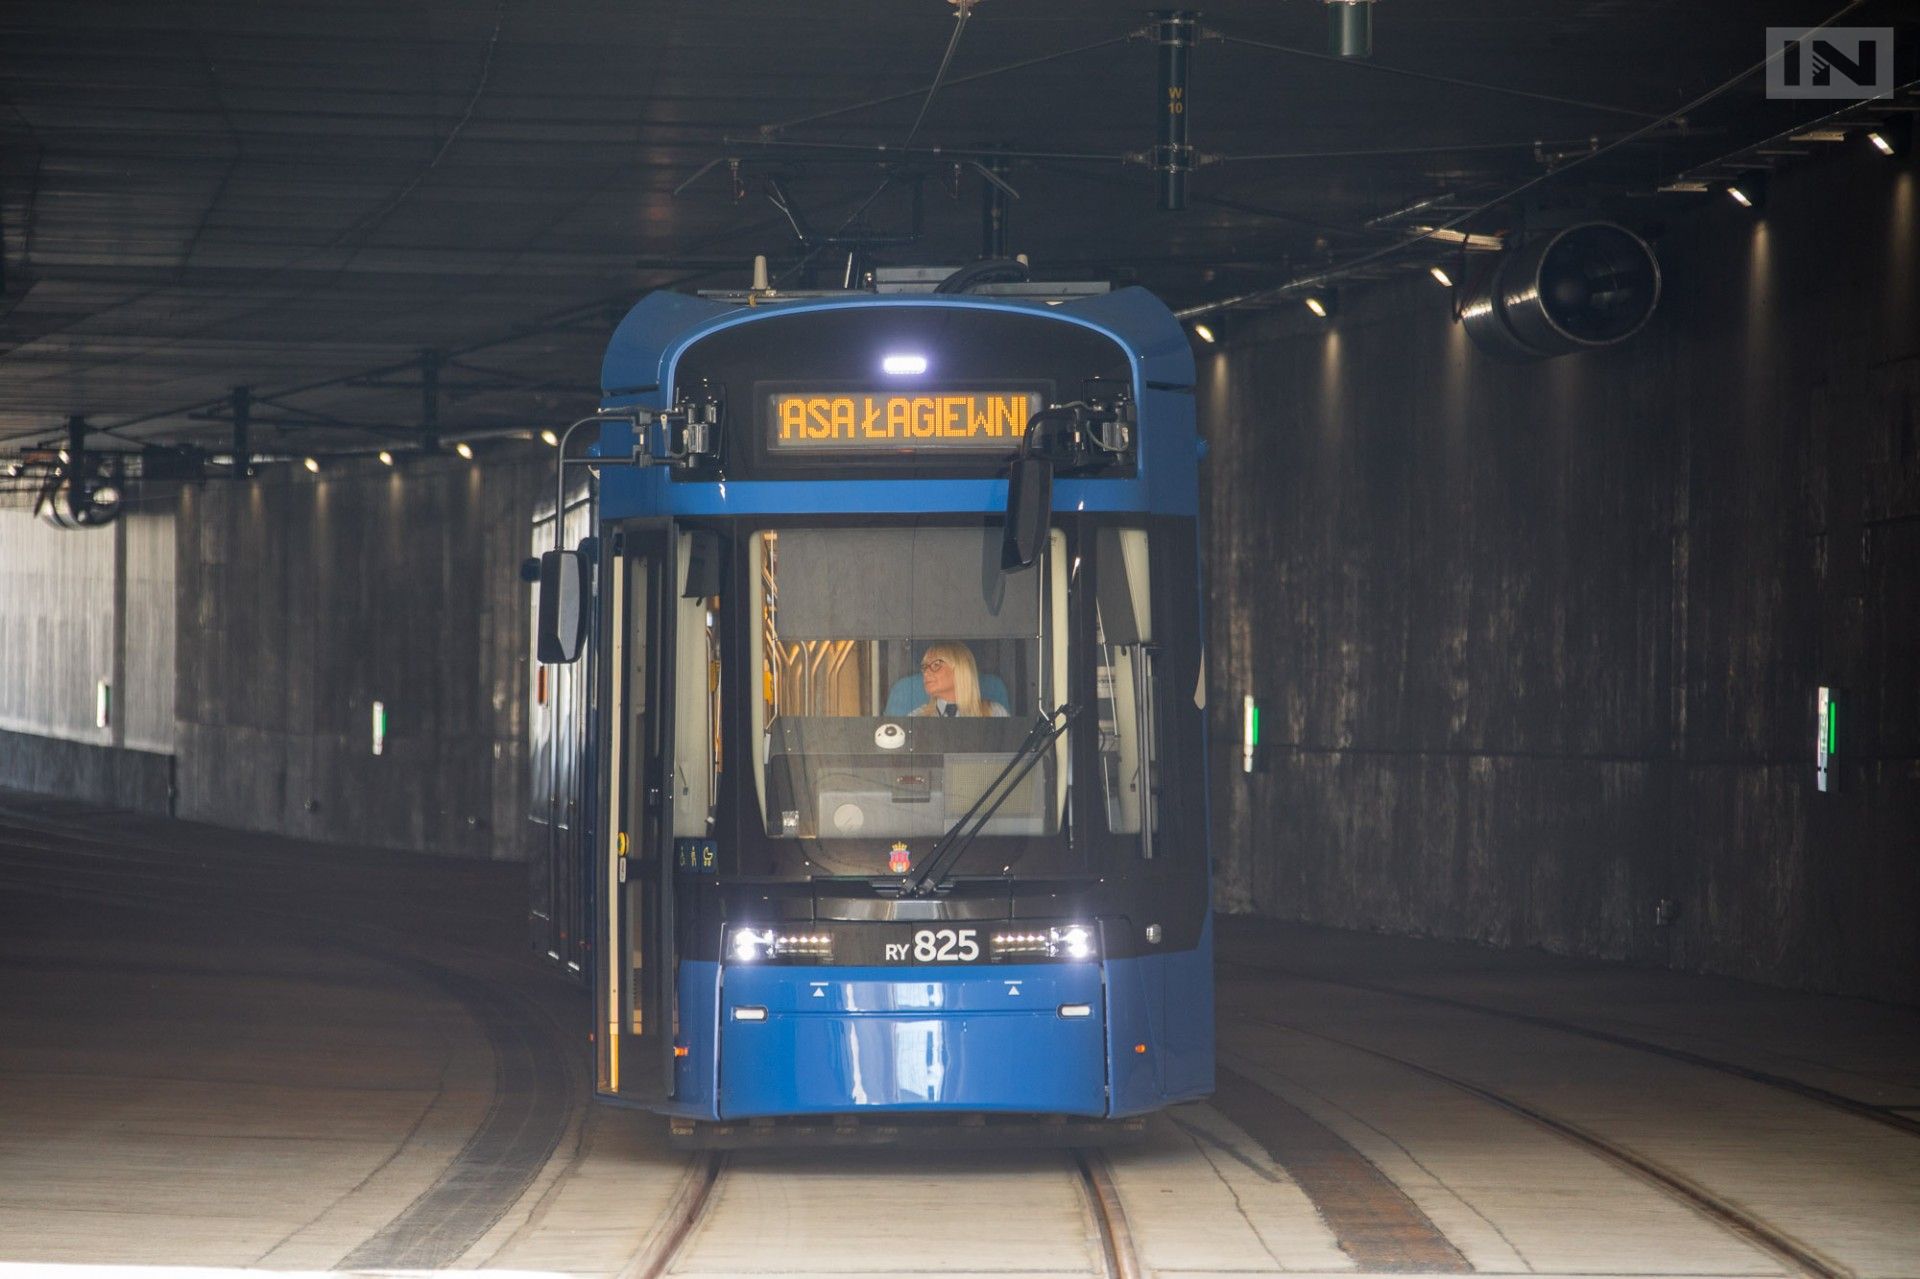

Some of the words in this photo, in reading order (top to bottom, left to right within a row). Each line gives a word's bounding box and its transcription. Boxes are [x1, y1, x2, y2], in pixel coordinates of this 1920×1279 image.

[1168, 87, 1183, 98] W
[1168, 102, 1183, 113] 10
[779, 398, 855, 439] ASA
[885, 943, 910, 961] RY
[914, 929, 980, 962] 825
